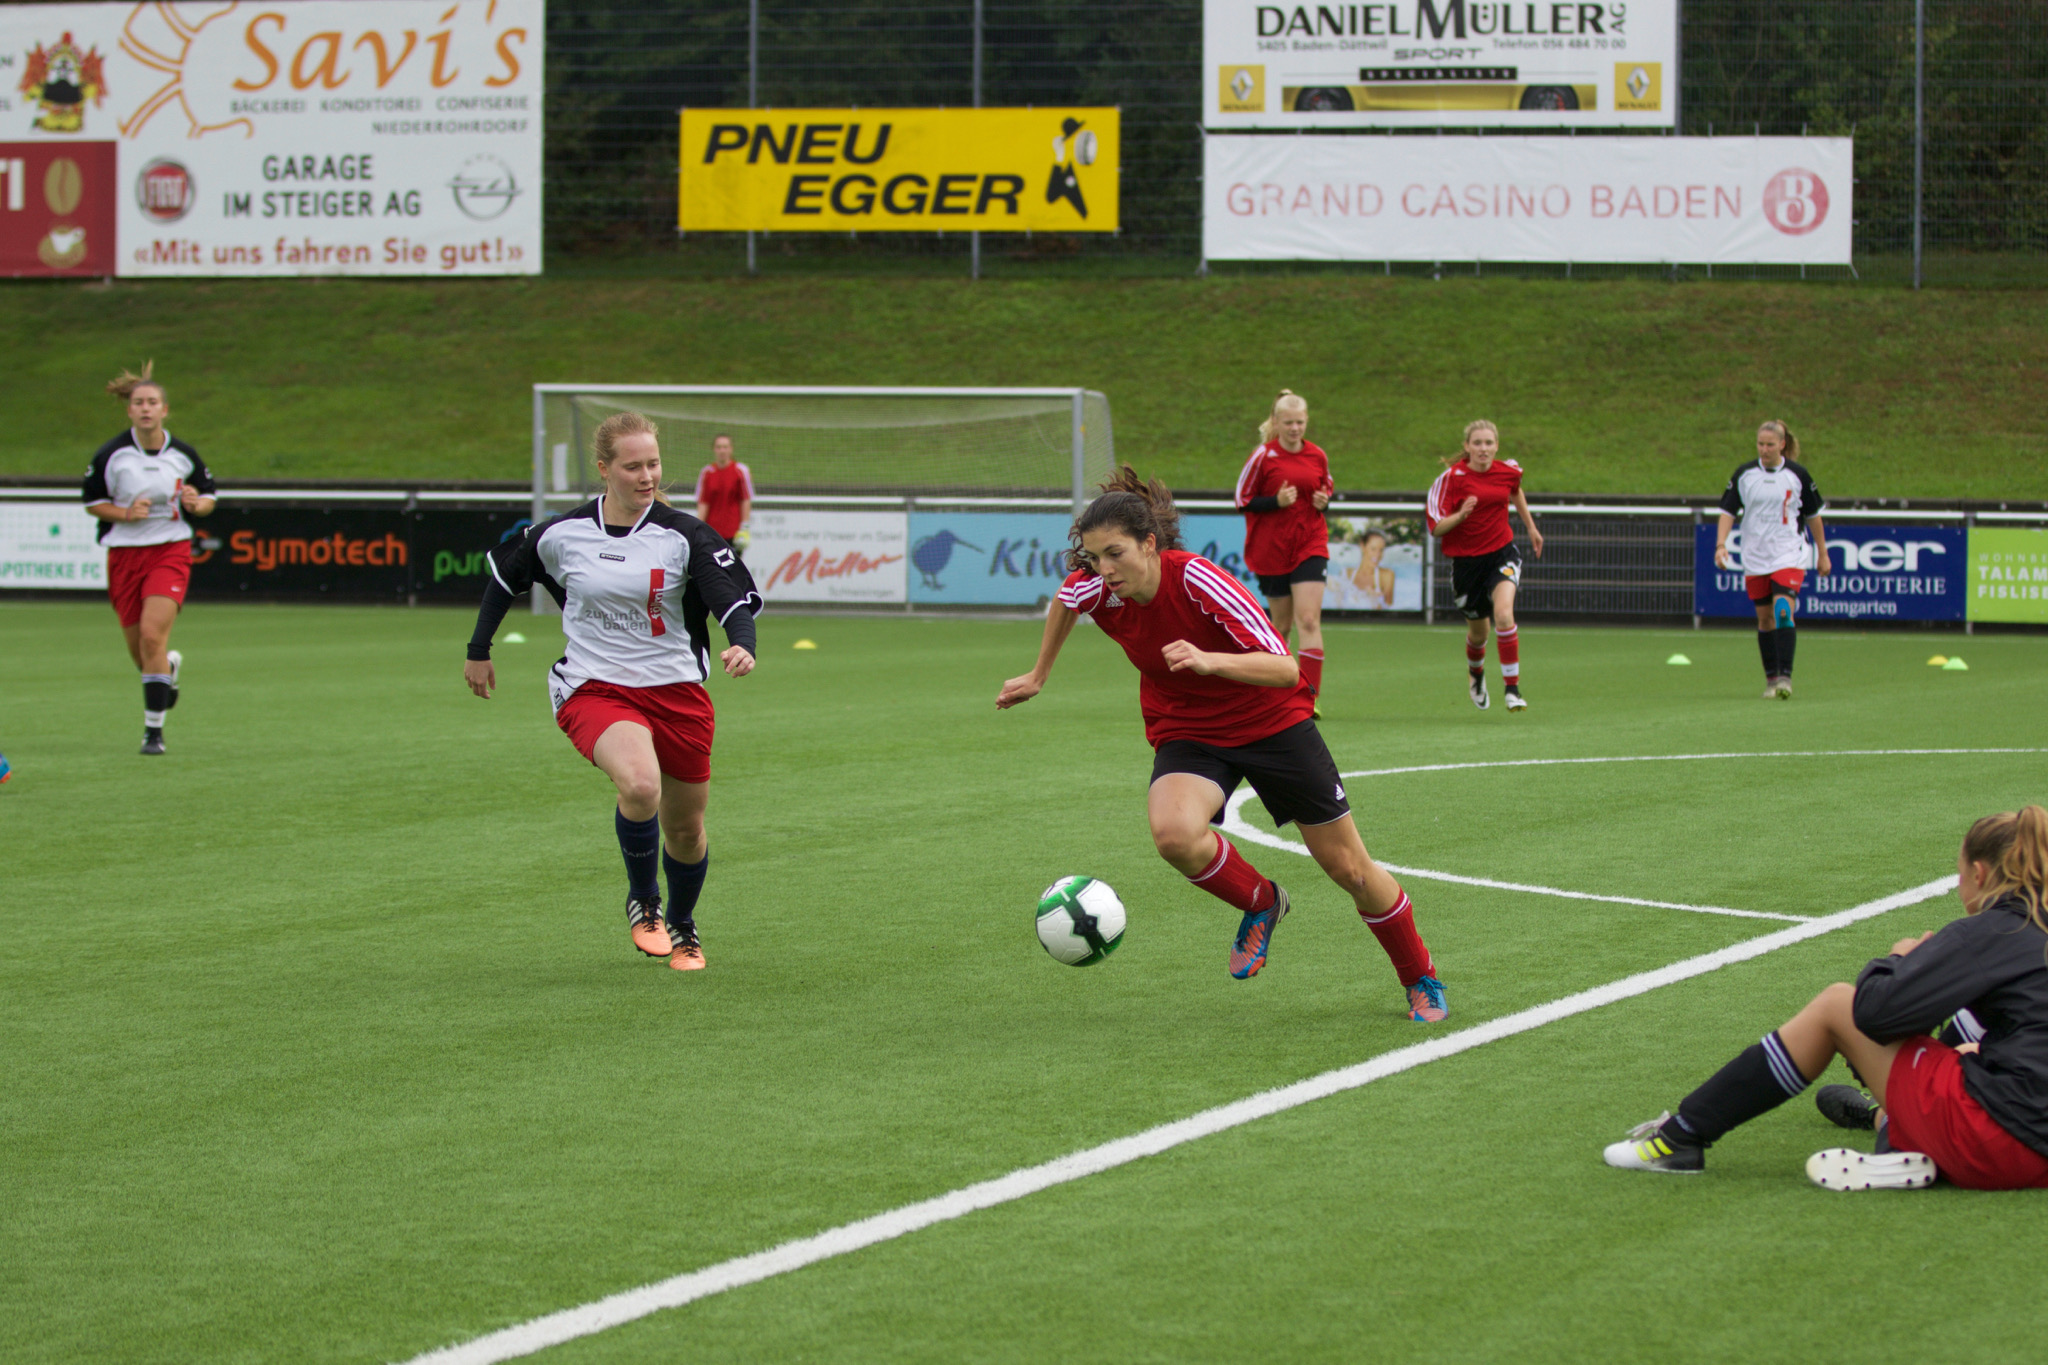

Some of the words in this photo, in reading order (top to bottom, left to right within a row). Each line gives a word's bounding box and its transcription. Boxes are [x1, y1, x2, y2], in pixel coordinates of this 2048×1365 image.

[1256, 5, 1410, 37] DANIEL
[1257, 40, 1287, 51] 5405
[1292, 39, 1388, 51] Baden-Dättwil
[1493, 38, 1538, 49] Telefon
[1542, 38, 1564, 49] 056
[1568, 38, 1590, 49] 484
[1594, 38, 1608, 49] 70
[1611, 39, 1626, 49] 00
[1393, 47, 1483, 61] SPORT
[320, 96, 421, 112] KONDITOREI
[436, 95, 529, 111] CONFISERIE
[372, 118, 529, 135] NIEDERROHRDORF
[703, 124, 892, 164] PNEU
[262, 155, 373, 181] GARAGE
[223, 192, 251, 218] IM
[262, 191, 373, 217] STEIGER
[384, 191, 421, 217] AG
[782, 174, 1025, 215] EGGER
[1226, 183, 1384, 217] GRAND
[1400, 184, 1571, 219] CASINO
[1590, 185, 1742, 219] BADEN
[213, 247, 263, 265] uns
[275, 238, 371, 265] fahren
[384, 238, 427, 263] Sie
[230, 530, 408, 571] Symotech
[0, 561, 76, 579] POTHEKE
[766, 547, 904, 591] Müller
[1815, 575, 1946, 595] BIJOUTERIE
[585, 608, 640, 622] zukunft
[1806, 598, 1898, 617] Bremgarten
[603, 616, 648, 632] bauen
